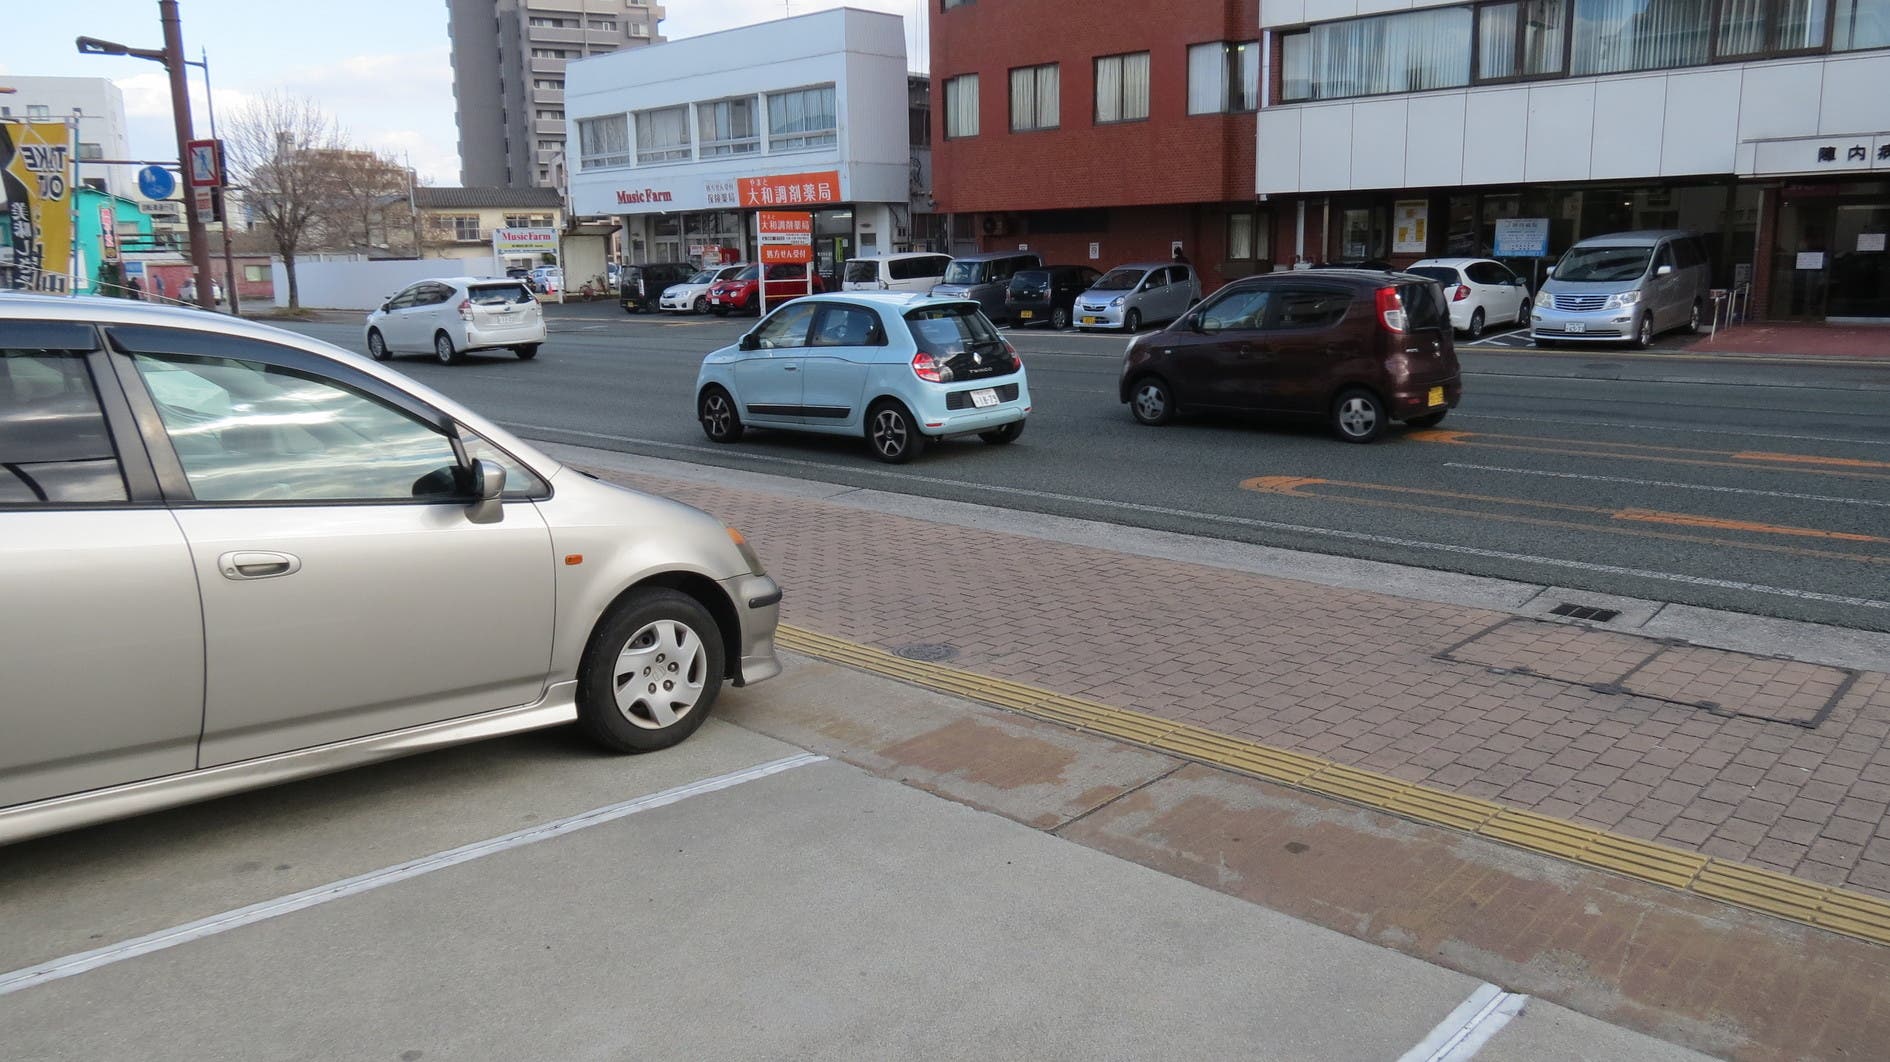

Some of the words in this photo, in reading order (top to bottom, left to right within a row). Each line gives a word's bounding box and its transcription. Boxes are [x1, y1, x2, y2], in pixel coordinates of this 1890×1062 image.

[616, 189, 644, 204] Music
[645, 188, 672, 203] Farm
[747, 182, 831, 205] 大和調剤薬局
[502, 231, 528, 241] Music
[528, 231, 551, 240] Farm
